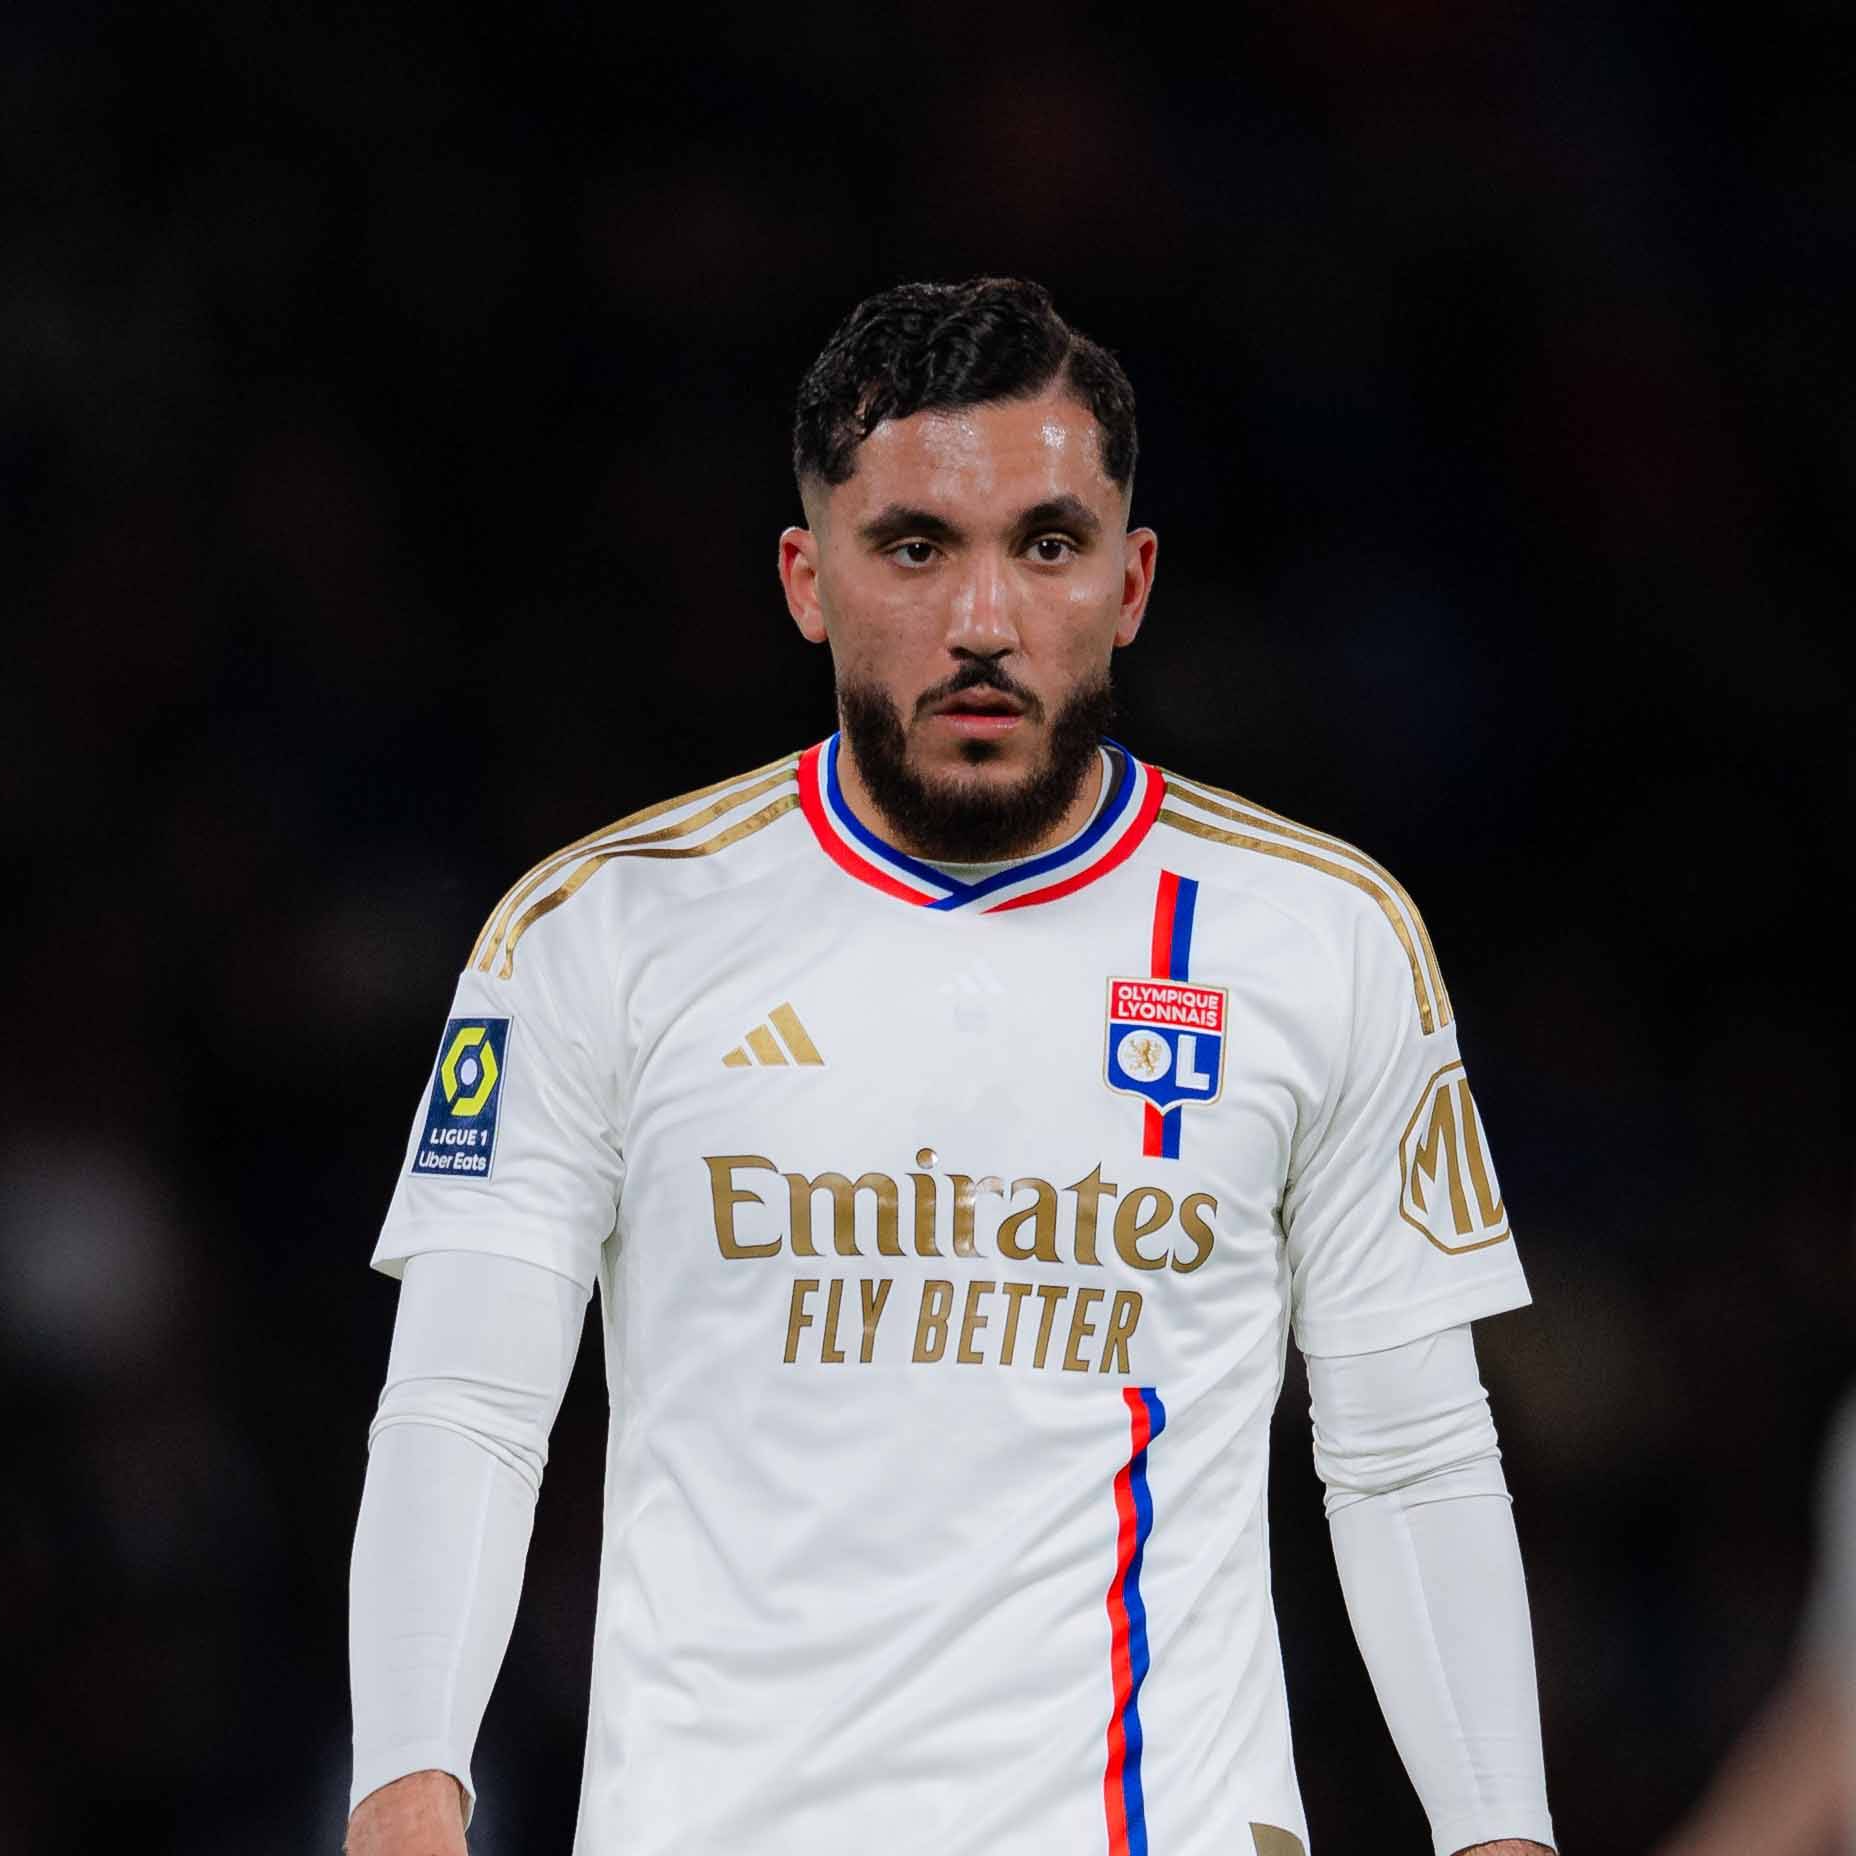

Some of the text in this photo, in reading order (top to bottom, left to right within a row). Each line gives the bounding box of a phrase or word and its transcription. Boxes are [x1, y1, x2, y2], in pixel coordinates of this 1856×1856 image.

[1118, 985, 1219, 1010] OLYMPIQUE
[1118, 1000, 1218, 1028] LYONNAIS
[1117, 1029, 1211, 1091] OL
[430, 1128, 489, 1146] LIGUE 1
[418, 1151, 487, 1172] Uber Eats
[701, 1146, 1219, 1274] Emirates
[783, 1278, 1144, 1374] FLY BETTER
